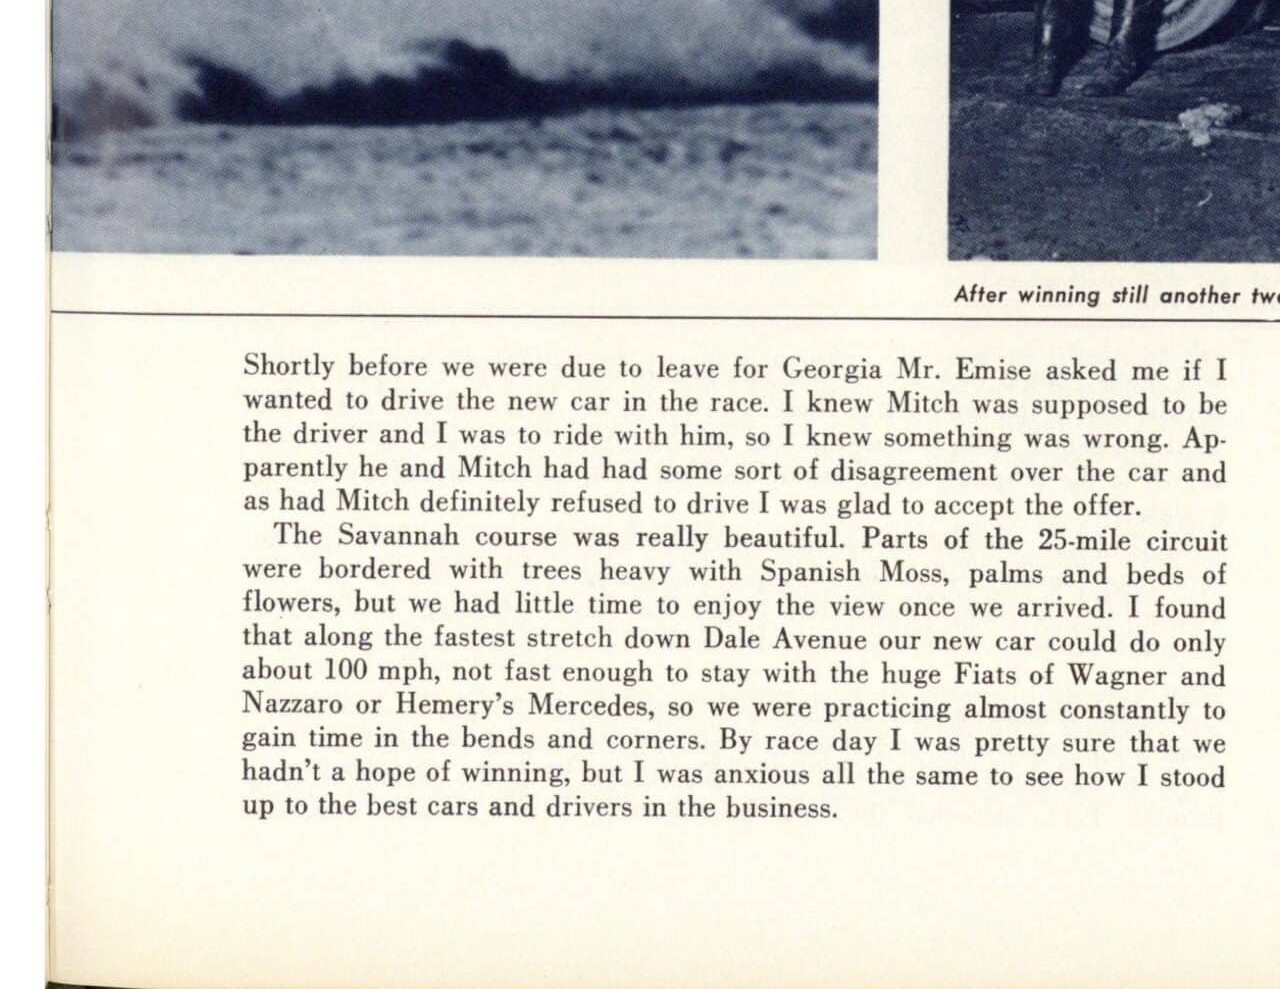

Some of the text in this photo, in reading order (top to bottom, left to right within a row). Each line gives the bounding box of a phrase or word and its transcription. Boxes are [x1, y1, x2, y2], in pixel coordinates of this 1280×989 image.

[952, 282, 1008, 304] After
[1017, 283, 1101, 309] winning
[1111, 283, 1150, 305] still
[1158, 283, 1242, 306] another
[243, 351, 1227, 385] Shortly before we were due to leave for Georgia Mr. Emise asked me if I
[243, 418, 1227, 455] the driver and I was to ride with him, so I knew something was wrong. Ap-
[272, 521, 1229, 554] The Savannah course was really beautiful. Parts of the 25-mile circuit
[241, 655, 1227, 691] about 100 mph, not fast enough to stay with the huge Fiats of Wagner and
[241, 723, 1227, 758] gain time in the bends and corners. By race day I was pretty sure that we
